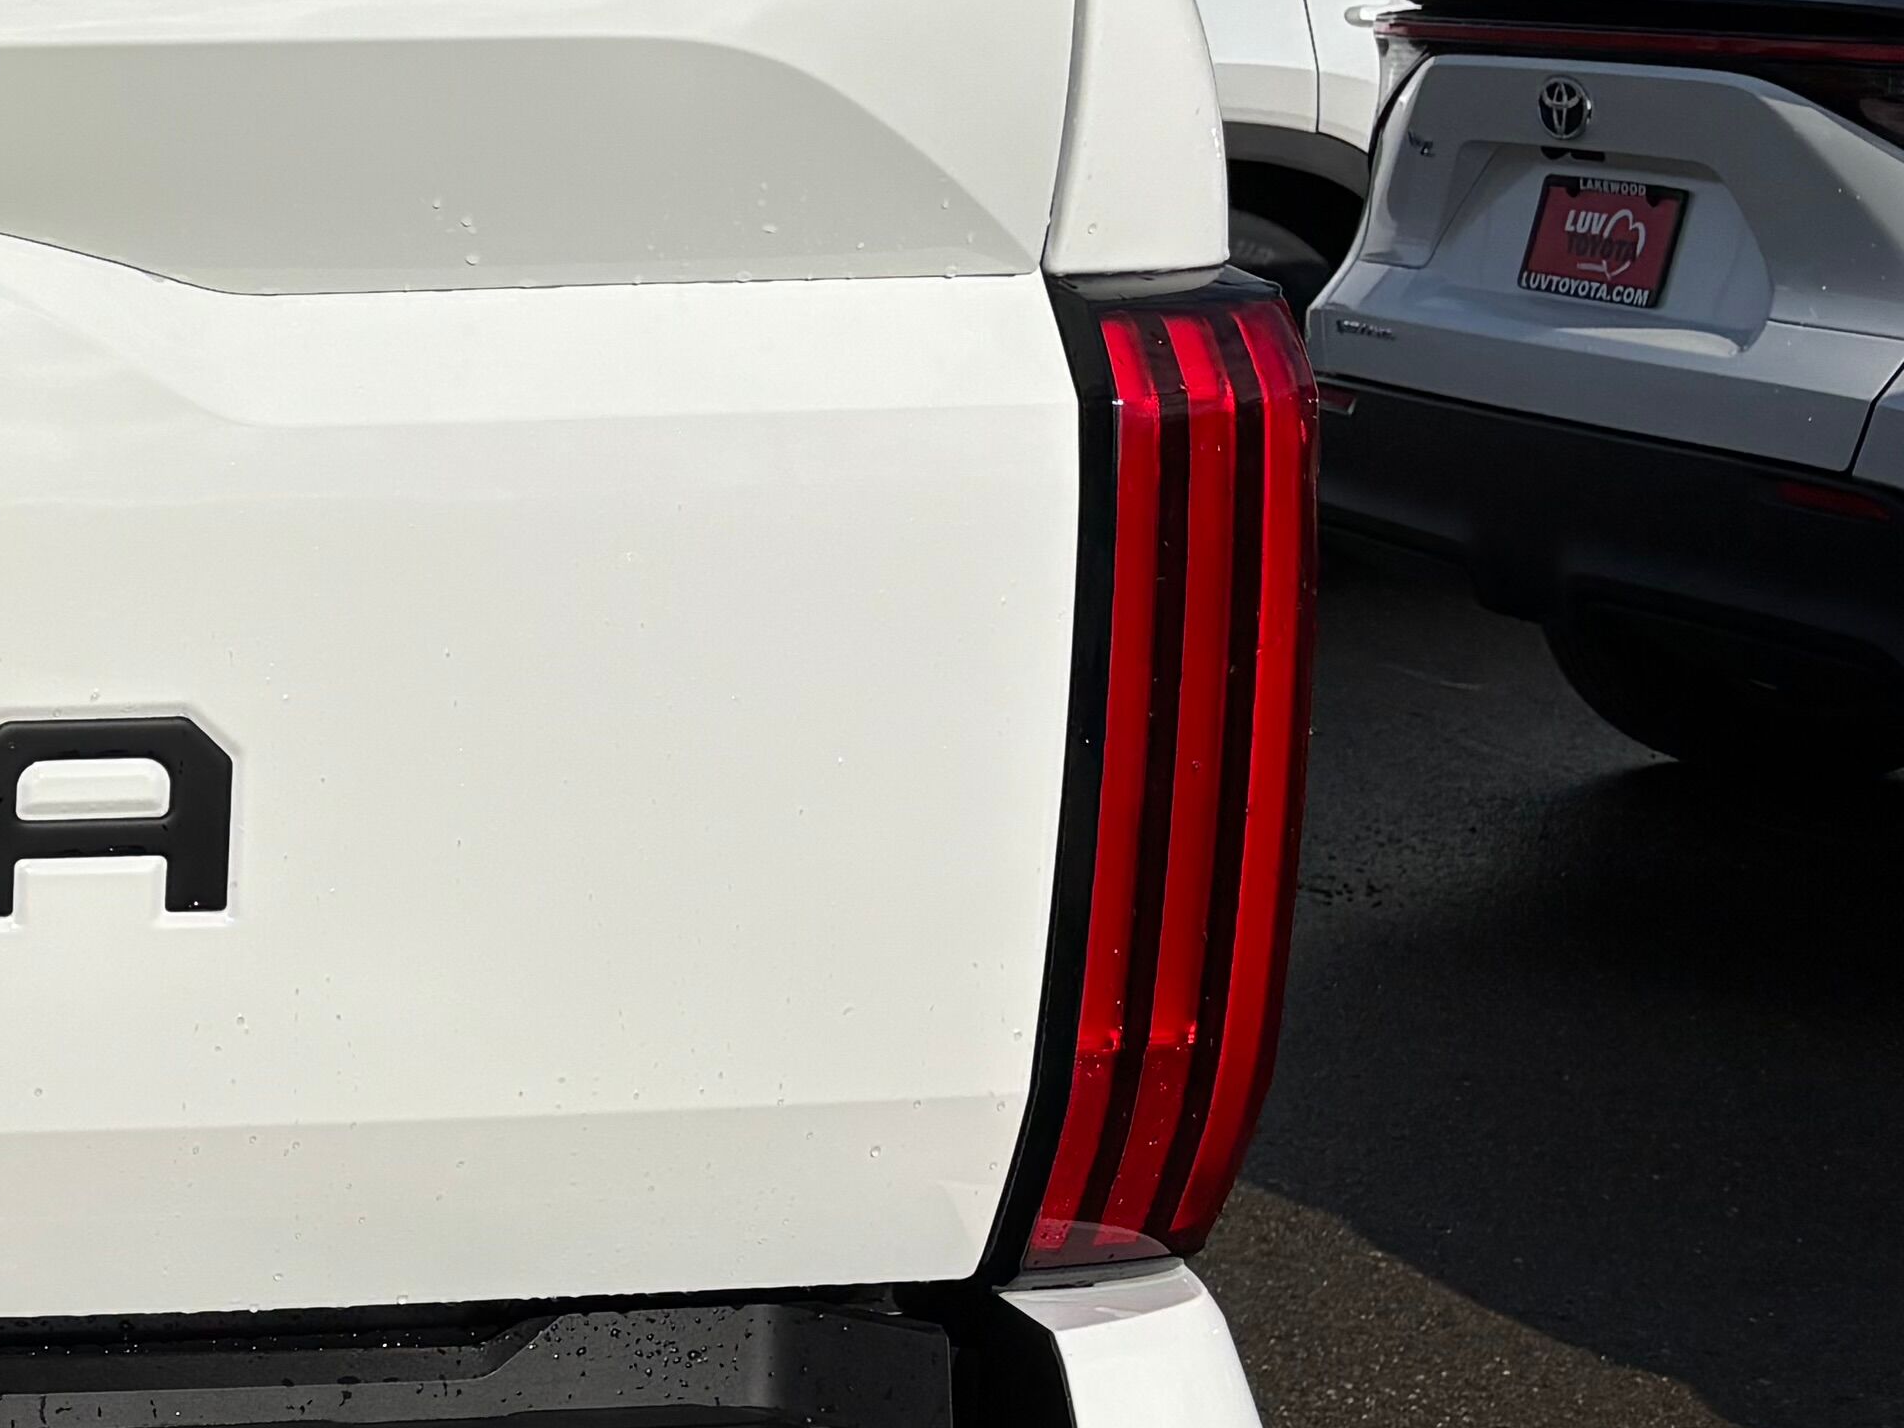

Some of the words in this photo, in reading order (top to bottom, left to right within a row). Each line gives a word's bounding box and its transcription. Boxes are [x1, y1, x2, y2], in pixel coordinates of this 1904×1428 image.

[1578, 177, 1647, 197] LAKEWOOD
[1565, 209, 1608, 234] LUV
[1567, 235, 1638, 262] TOYOTA
[1521, 271, 1649, 306] LUVTOYOTA.COM
